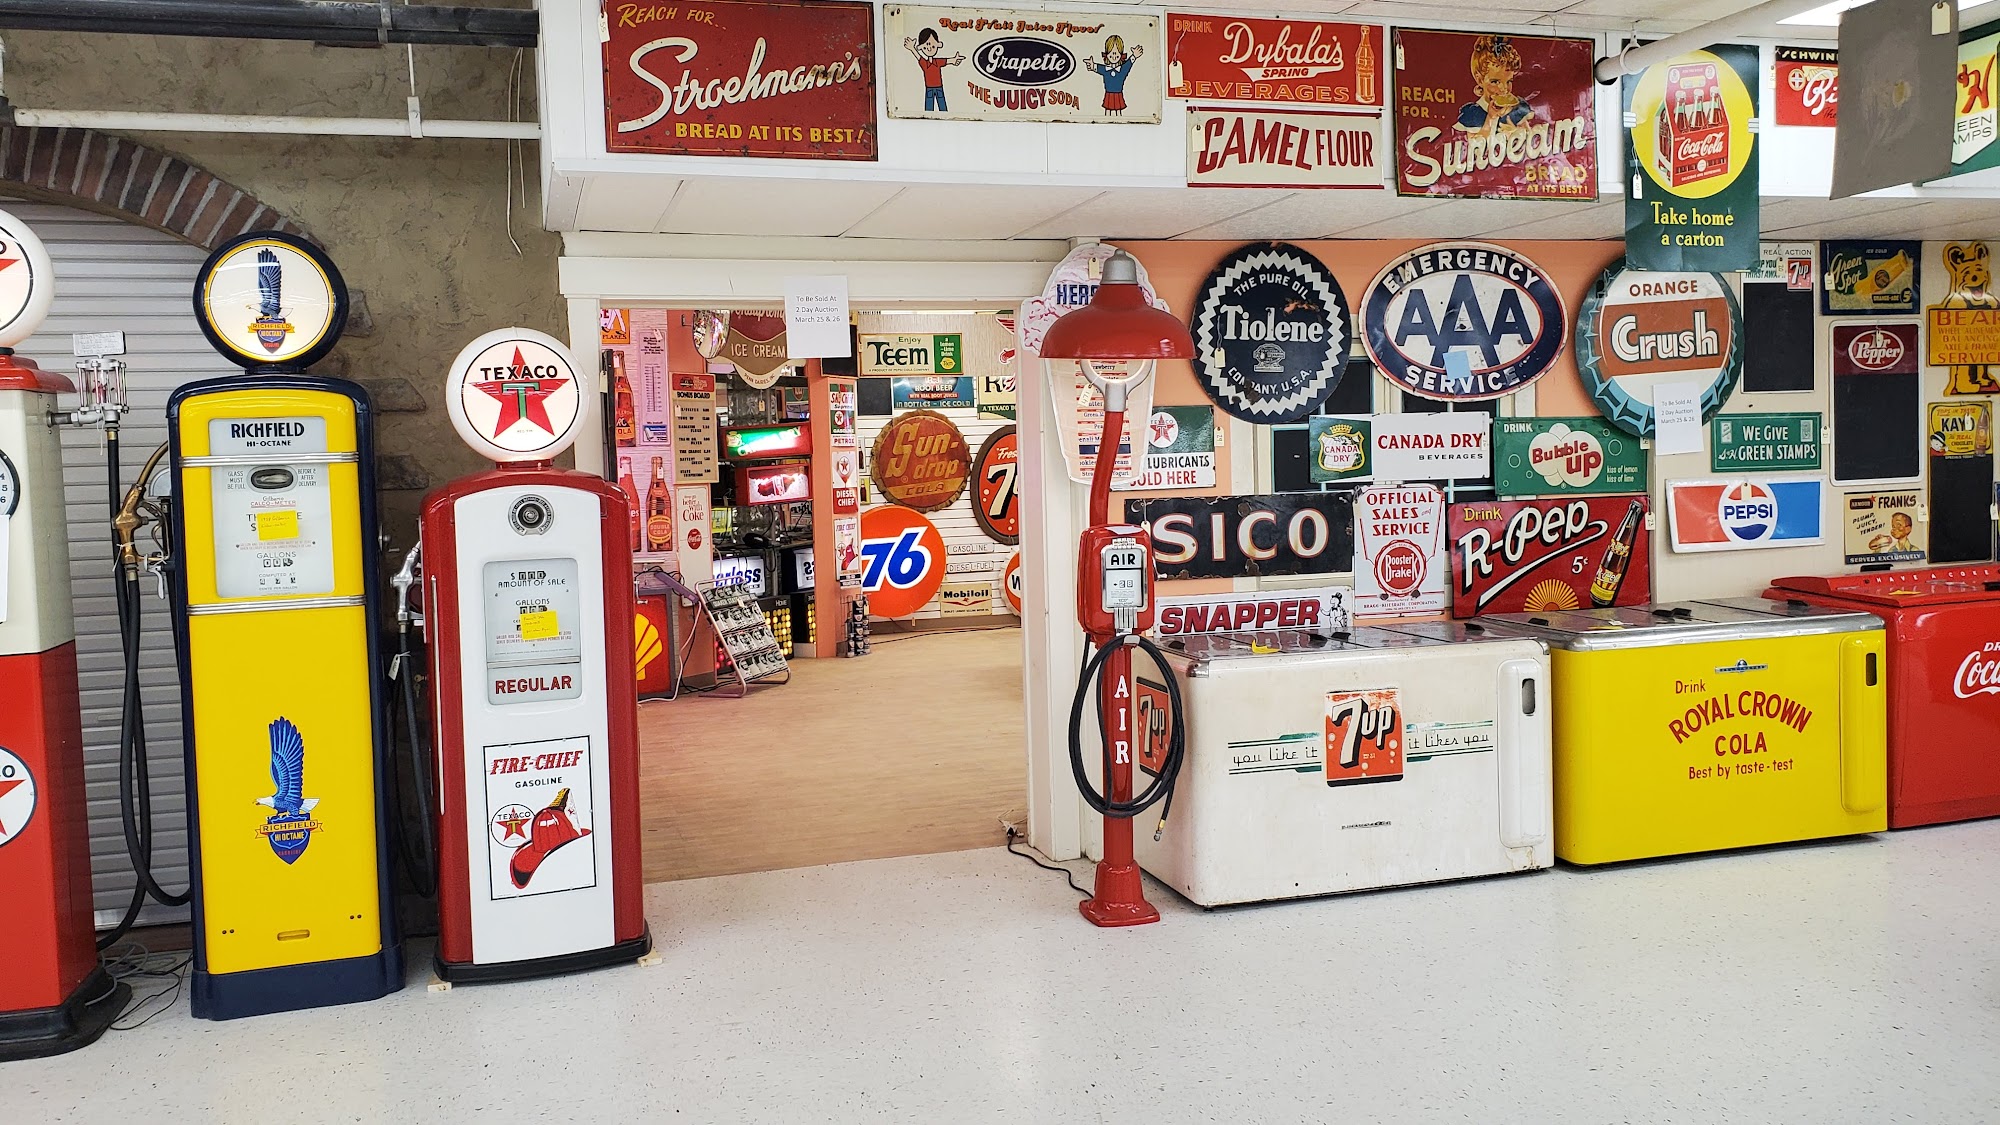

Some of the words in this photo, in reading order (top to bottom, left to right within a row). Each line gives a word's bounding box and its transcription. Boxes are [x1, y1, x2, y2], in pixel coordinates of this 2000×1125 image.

[617, 3, 677, 28] REACH
[939, 17, 974, 31] Real
[975, 17, 1014, 32] Fruit
[1016, 19, 1055, 34] Juice
[1056, 20, 1106, 38] Flavor
[1174, 19, 1213, 33] DRINK
[986, 43, 1066, 79] Grapette
[1261, 67, 1310, 78] SPRING
[616, 36, 863, 134] Stroehmann's
[1175, 80, 1351, 103] BEVERAGES
[967, 80, 992, 106] THE
[993, 88, 1047, 111] JUICY
[1047, 87, 1081, 111] SODA
[1401, 86, 1456, 104] REACH
[675, 122, 742, 140] BREAD
[749, 125, 769, 141] AT
[775, 126, 803, 142] ITS
[809, 126, 865, 144] BEST!
[1196, 116, 1313, 175] CAMEL
[1315, 129, 1375, 168] FLOUR
[1404, 114, 1590, 187] Sunbeam
[1525, 162, 1588, 184] BREAD
[1526, 184, 1540, 194] AT
[1542, 184, 1557, 194] ITS
[1651, 201, 1688, 226] Take
[1692, 208, 1735, 227] home
[1660, 234, 1671, 247] a
[1675, 231, 1726, 248] carton
[1382, 249, 1541, 295] EMERGENCY
[1233, 276, 1258, 297] THE
[1259, 273, 1291, 288] PURE
[1291, 280, 1310, 300] OIL
[1629, 280, 1698, 297] ORANGE
[830, 295, 838, 303] At
[795, 306, 800, 314] 2
[801, 306, 814, 315] Day
[814, 305, 839, 314] Auction
[795, 316, 815, 324] March
[833, 315, 841, 323] 26
[1219, 303, 1325, 343] Tiolene
[1393, 273, 1535, 369] AAA
[898, 335, 923, 345] Enjoy
[1611, 310, 1719, 363] Crush
[731, 342, 748, 358] ICE
[753, 342, 786, 359] CREAM
[1855, 341, 1900, 365] Pepper
[480, 364, 558, 381] TEXACO
[1404, 364, 1521, 395] SERVICE
[677, 391, 694, 400] BONUS
[694, 392, 711, 400] BOARD
[915, 384, 935, 392] ROOT
[936, 383, 953, 392] BEER
[939, 400, 952, 408] ICE
[988, 404, 1010, 412] TEXACO
[1675, 408, 1694, 416] Auction
[231, 422, 305, 439] RICHFIELD
[1503, 423, 1533, 434] DRINK
[246, 440, 292, 448] HI-OCTANE
[1324, 445, 1358, 454] CANADA
[1377, 433, 1445, 450] CANADA
[1450, 433, 1482, 448] DRY
[1333, 455, 1350, 463] DRY
[1419, 453, 1484, 461] BEVERAGES
[1532, 440, 1589, 465] Bubble
[1739, 445, 1773, 461] GREEN
[1776, 444, 1817, 460] STAMPS
[913, 458, 960, 480] drop
[1148, 455, 1210, 470] LUBRICANTS
[1566, 451, 1602, 478] up
[1606, 466, 1617, 474] kiss
[1618, 465, 1624, 473] of
[1624, 465, 1638, 473] lemon
[227, 470, 244, 478] GLASS
[1167, 470, 1197, 486] HERE
[1606, 474, 1617, 483] kiss
[1618, 474, 1624, 482] of
[1624, 474, 1635, 482] lime
[836, 489, 855, 499] DIESEL
[904, 481, 945, 497] COLA
[838, 498, 855, 507] CHIEF
[1366, 490, 1435, 506] OFFICIAL
[1878, 495, 1917, 509] FRANKS
[682, 509, 705, 522] Coke
[1372, 506, 1419, 521] SALES
[1464, 507, 1503, 522] Drink
[1724, 503, 1773, 520] PEPSI
[1152, 507, 1330, 565] SICO
[1372, 521, 1430, 537] SERVICE
[256, 551, 297, 559] GALLONS
[952, 544, 988, 553] GASOLINE
[861, 526, 929, 592] 76
[1110, 553, 1136, 567] AIR
[1850, 556, 1876, 564] SERVED
[1878, 552, 1922, 563] EXCLUSIVELY
[498, 580, 532, 589] AMOUNT
[547, 578, 567, 587] SALE
[1876, 574, 1919, 584] HAVE
[1930, 572, 1938, 580] A
[1948, 568, 1990, 580] COKE
[515, 598, 550, 606] GALLONS
[943, 589, 989, 600] Mobiloil
[775, 599, 788, 607] HOME
[1159, 598, 1321, 635] SNAPPER
[495, 675, 572, 695] REGULAR
[1675, 678, 1707, 695] Drink
[1667, 693, 1736, 745] ROYAL
[1737, 690, 1814, 734] CROWN
[1331, 697, 1395, 769] 7up
[1408, 737, 1420, 750] it
[1463, 734, 1490, 748] you
[1714, 731, 1768, 757] COLA
[1233, 753, 1262, 768] you
[1269, 746, 1299, 761] like
[1305, 746, 1319, 760] it
[1689, 766, 1713, 781] Best
[1716, 762, 1732, 781] by
[514, 776, 563, 789] GASOLINE
[497, 811, 531, 821] TEXACO
[262, 820, 317, 833] RICHFIELD
[274, 833, 282, 842] HI
[281, 831, 305, 841] OCTANE
